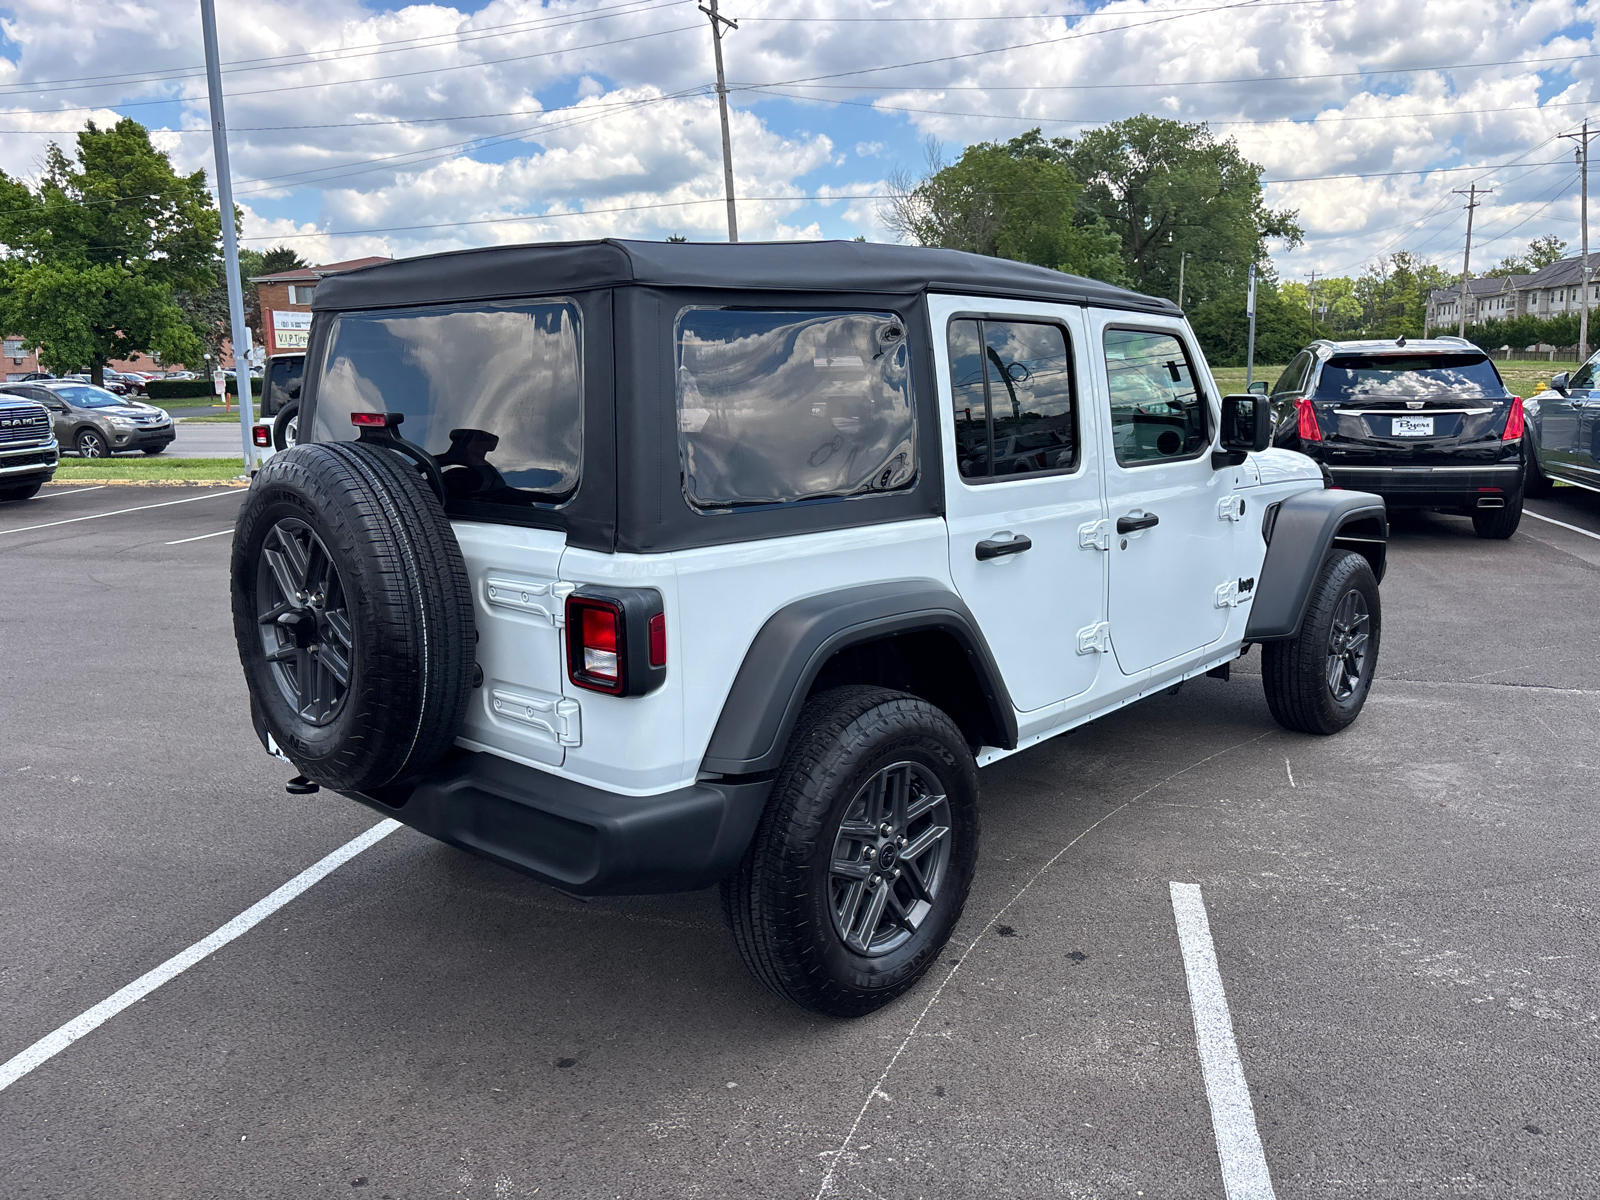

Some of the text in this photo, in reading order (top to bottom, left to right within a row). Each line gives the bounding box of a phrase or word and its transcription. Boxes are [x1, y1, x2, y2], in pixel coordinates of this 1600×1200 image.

[1, 418, 36, 427] RAM
[1395, 420, 1430, 431] Byers
[1238, 577, 1255, 594] Jeep
